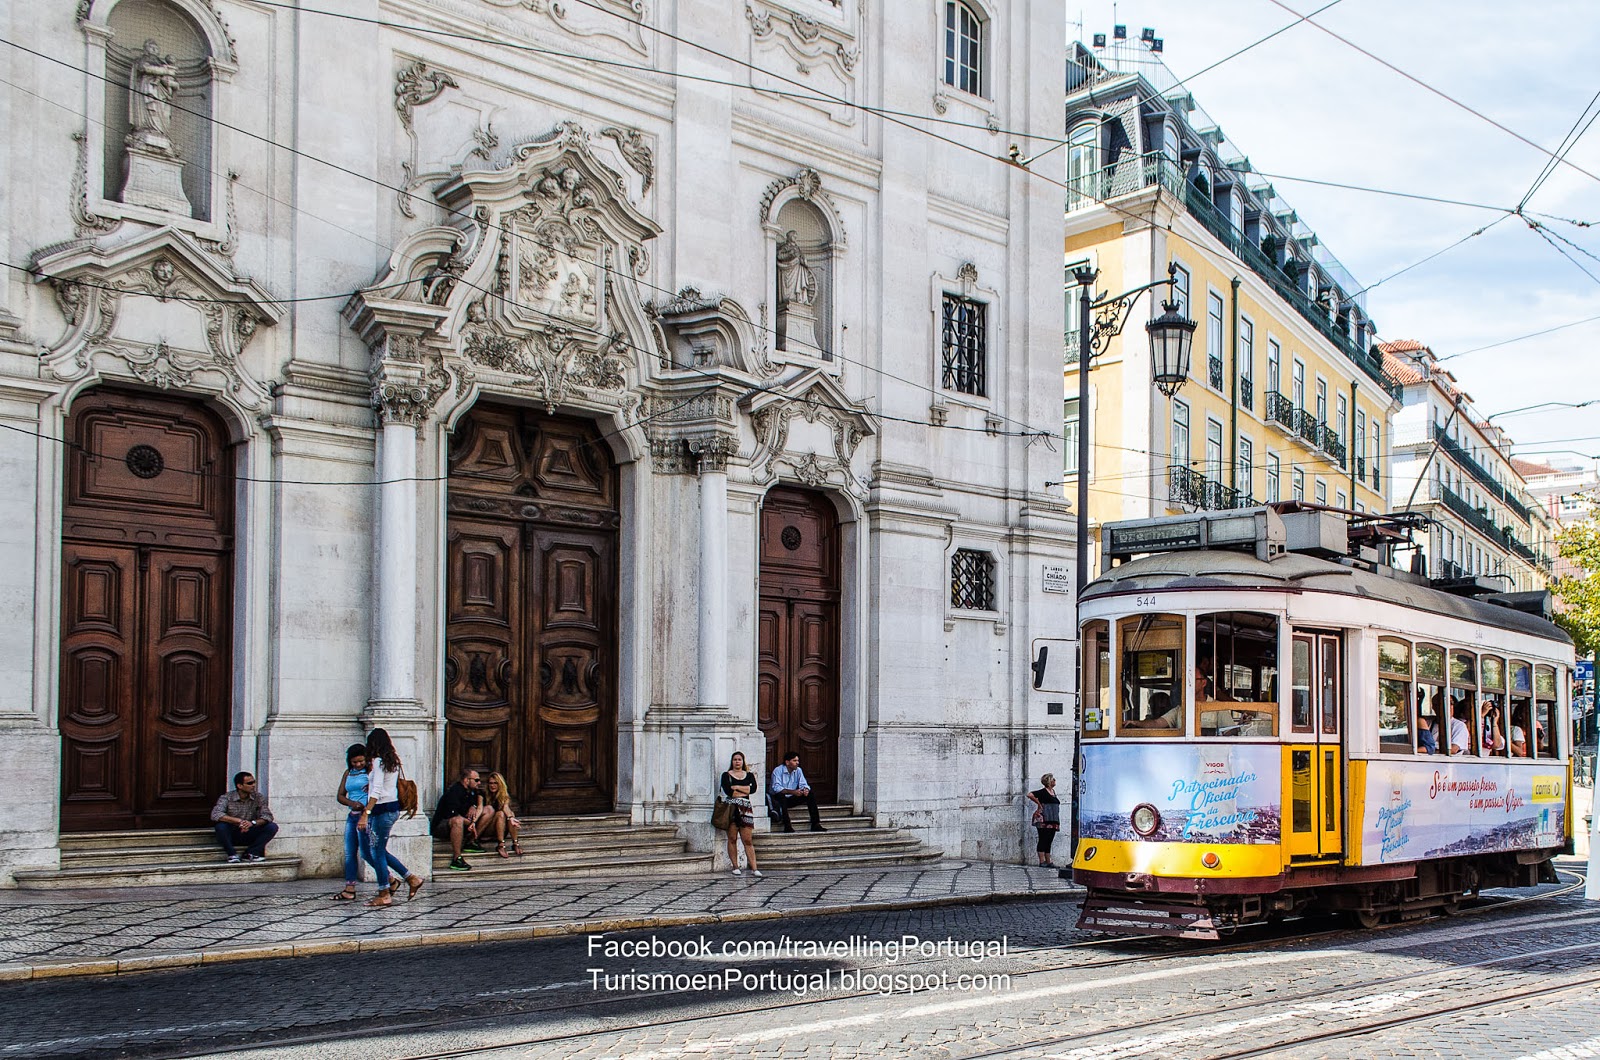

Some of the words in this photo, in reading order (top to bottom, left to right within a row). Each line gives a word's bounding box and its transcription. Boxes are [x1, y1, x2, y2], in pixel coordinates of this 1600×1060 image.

[1046, 573, 1067, 581] CHIADO
[1136, 596, 1156, 607] 544
[1575, 665, 1585, 678] P
[1167, 771, 1258, 801] Patrocinador
[1429, 770, 1442, 799] Se
[1447, 781, 1457, 792] um
[1457, 779, 1480, 796] passeio
[1190, 787, 1239, 811] Oficial
[1473, 799, 1484, 809] um
[1483, 796, 1505, 812] passeio
[1206, 806, 1219, 815] da
[1183, 810, 1259, 839] Frescura.
